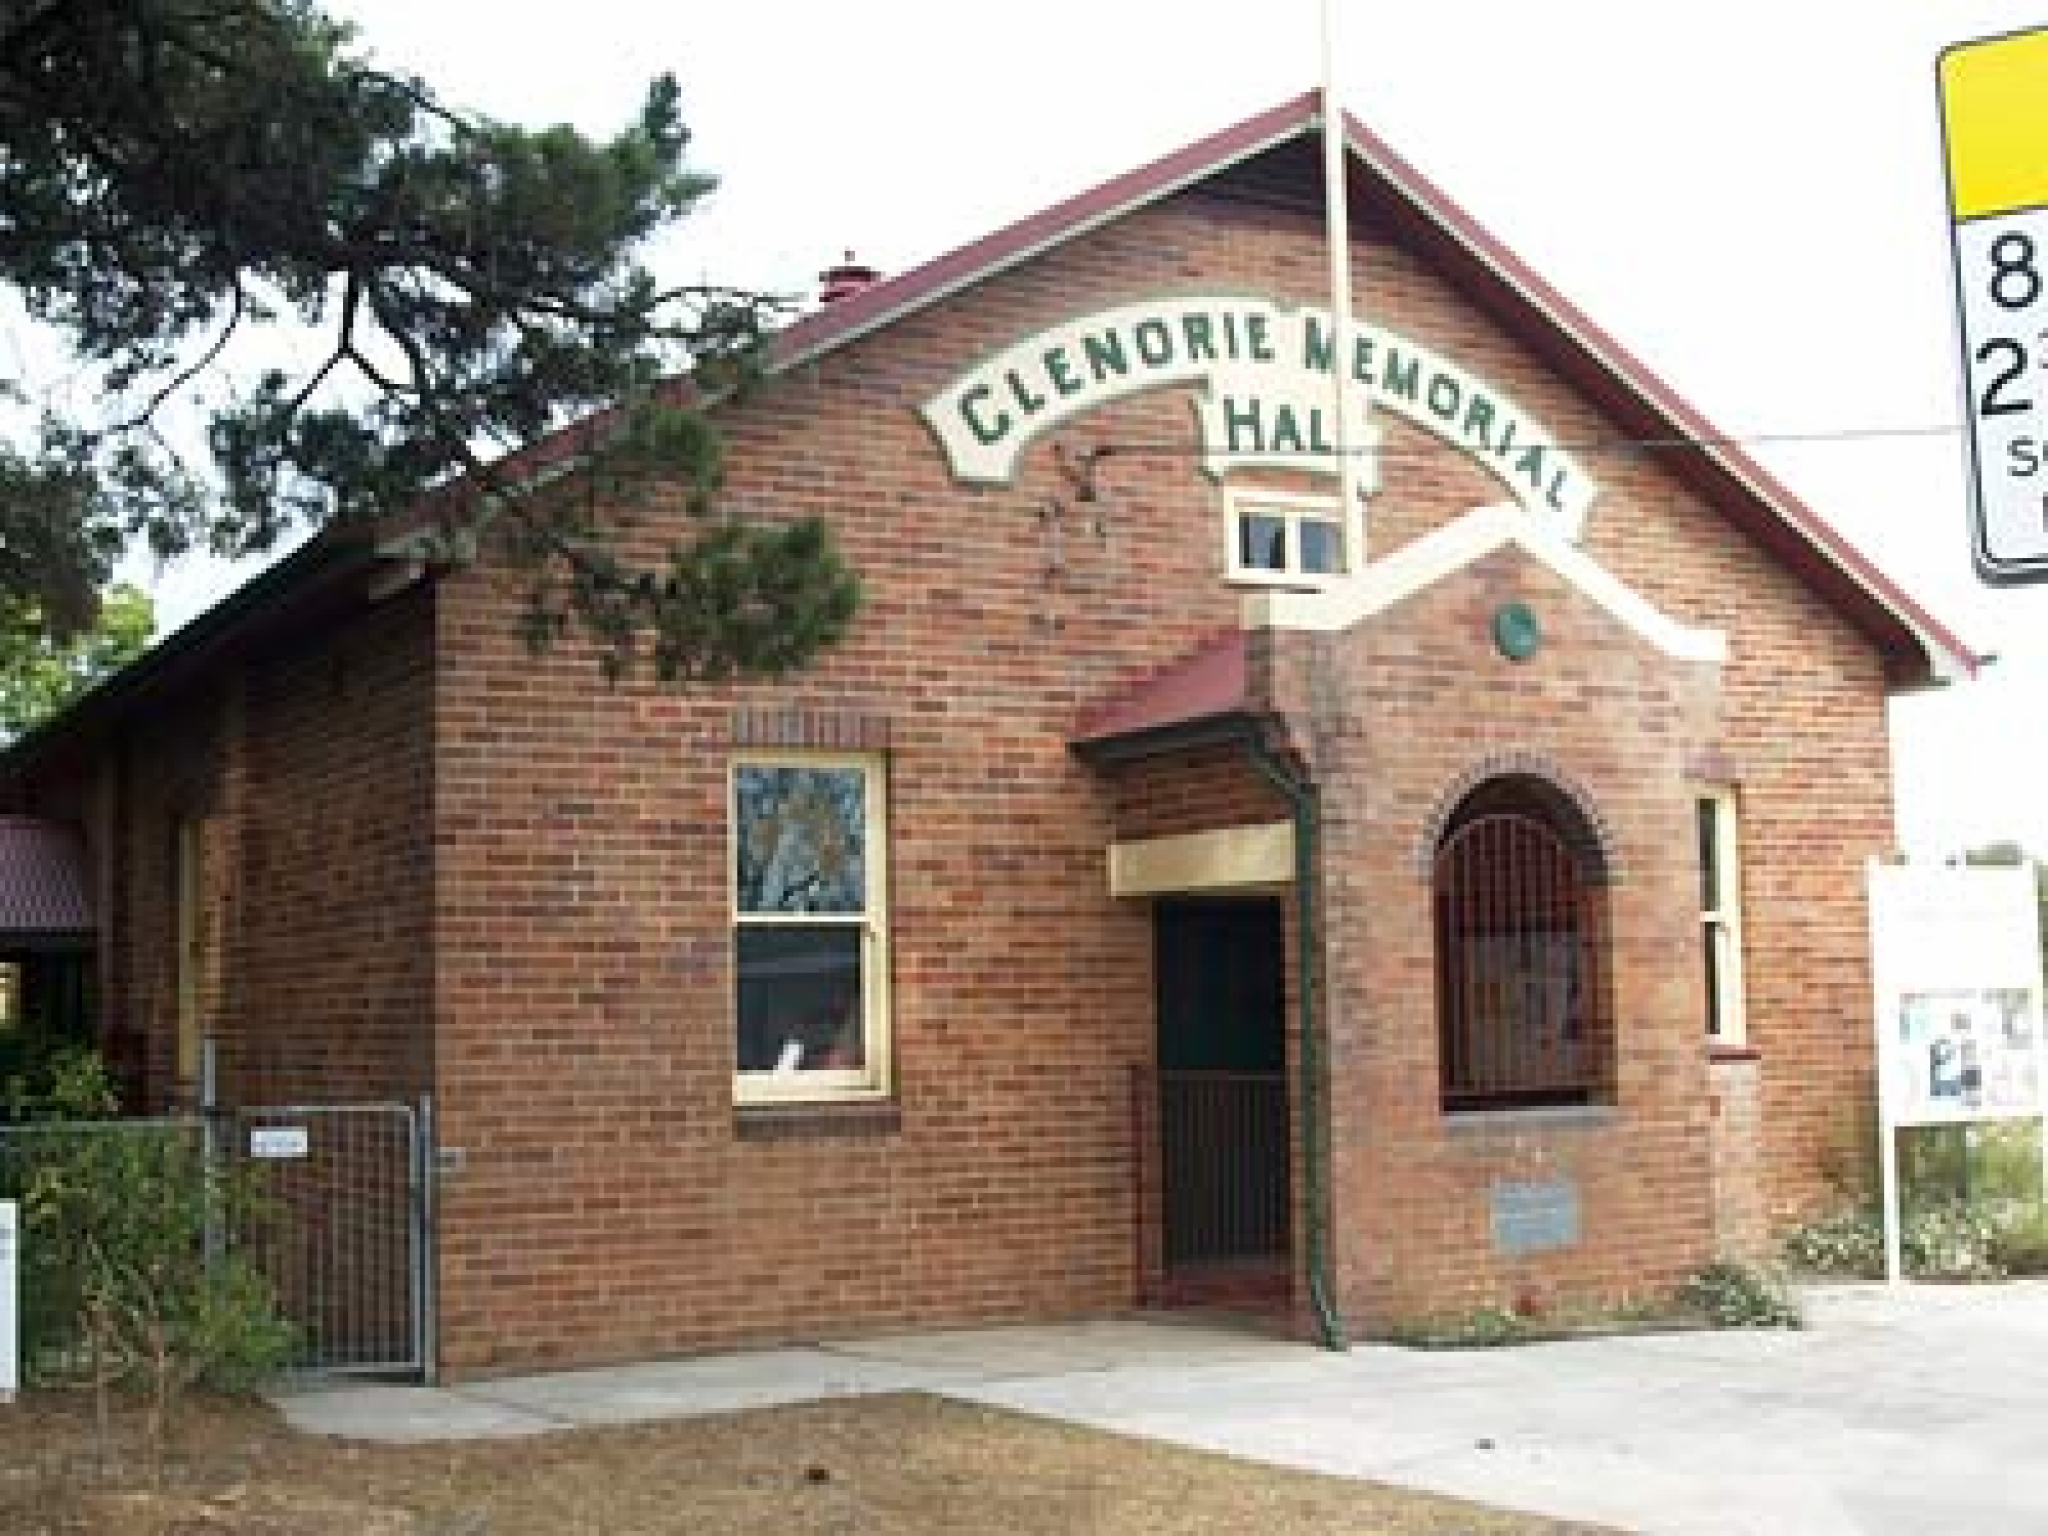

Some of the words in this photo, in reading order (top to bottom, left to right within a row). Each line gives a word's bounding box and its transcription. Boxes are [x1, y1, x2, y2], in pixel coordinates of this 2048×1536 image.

[1976, 332, 2048, 415] 2
[1223, 396, 1334, 454] HAL
[1303, 317, 1567, 512] MEMORIAL
[2006, 434, 2048, 478] S
